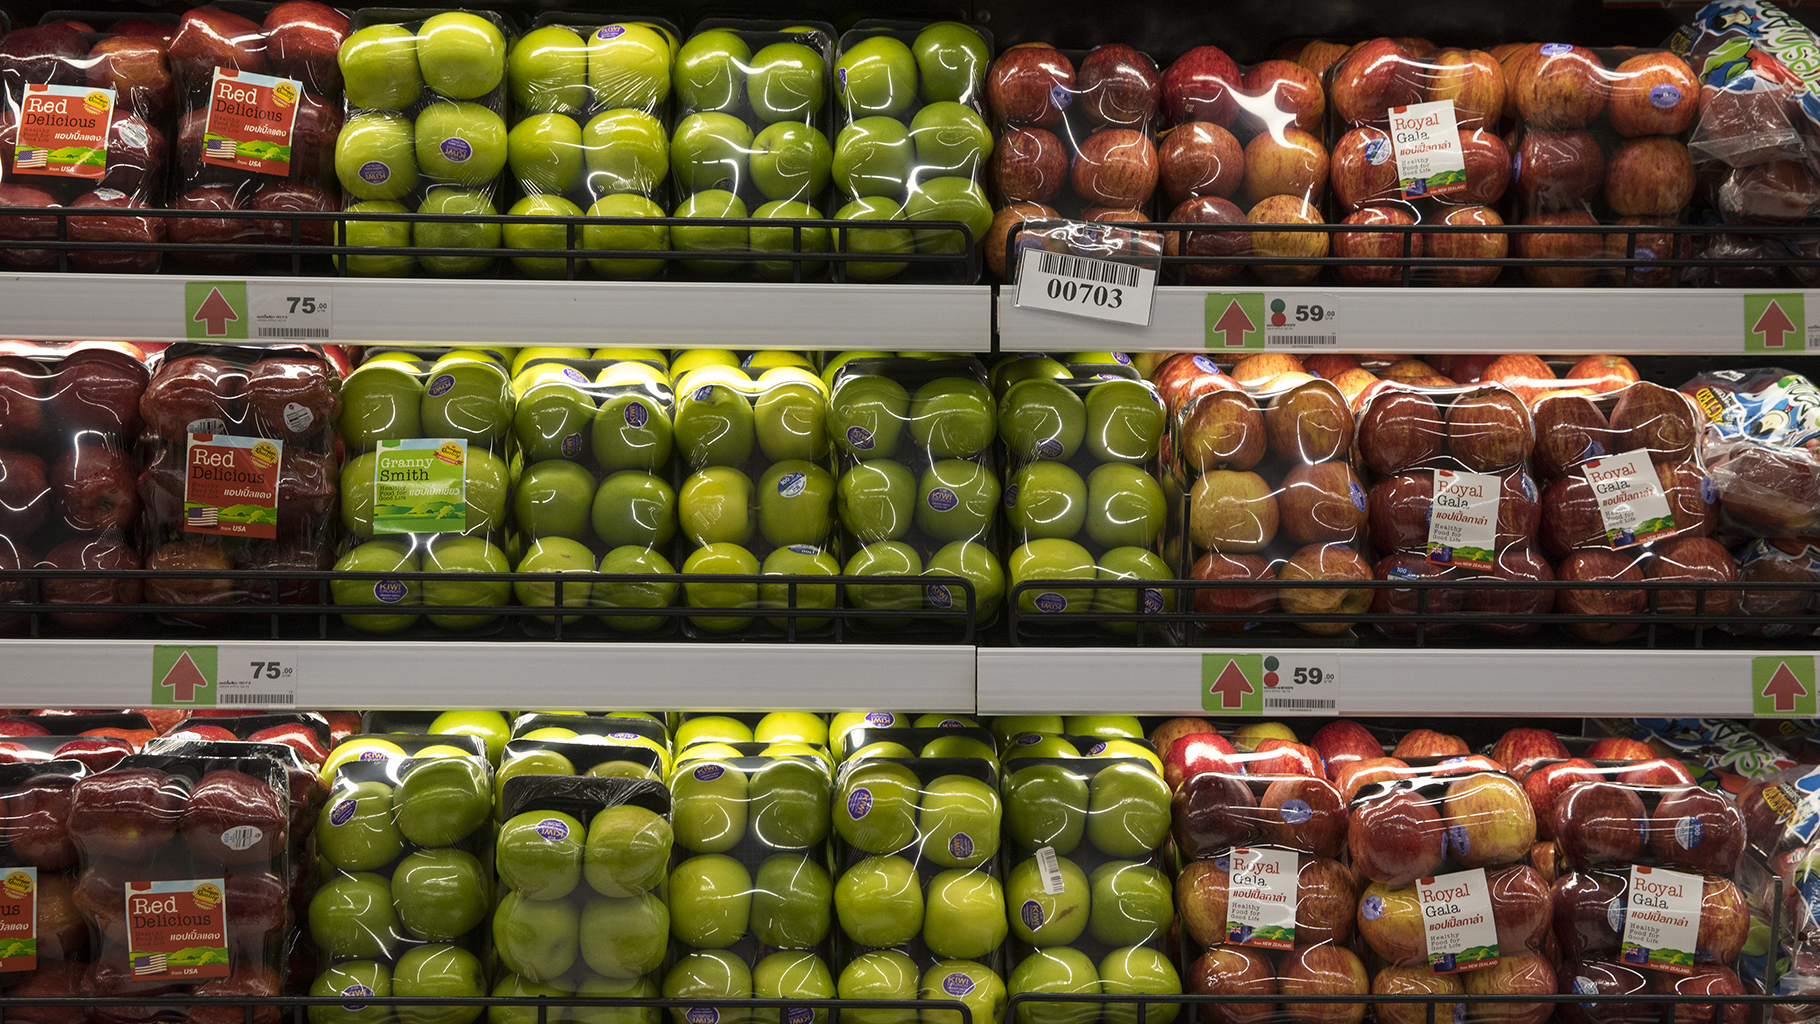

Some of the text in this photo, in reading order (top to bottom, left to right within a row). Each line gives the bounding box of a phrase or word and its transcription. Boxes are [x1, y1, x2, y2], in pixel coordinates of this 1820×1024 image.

[217, 83, 257, 105] Red
[27, 98, 67, 114] Red
[215, 99, 282, 122] Delicious
[25, 114, 96, 128] Delicious
[1394, 113, 1440, 131] Royal
[1397, 131, 1430, 143] Gala
[446, 148, 466, 158] KIWI
[1047, 278, 1123, 308] 00703
[193, 449, 234, 468] Red
[381, 458, 433, 469] Granny
[192, 466, 264, 484] Delicious
[381, 469, 429, 482] Smith
[1589, 463, 1637, 483] Royal
[780, 477, 791, 486] 100
[1438, 480, 1482, 497] Royal
[1597, 481, 1630, 494] Gala
[931, 492, 952, 500] KIWI
[1438, 495, 1469, 509] Gala
[930, 584, 950, 600] KIWI
[696, 764, 718, 773] KIWI
[333, 802, 350, 818] KIWI
[858, 793, 869, 815] KIWI
[542, 829, 564, 838] KIWI
[1233, 858, 1280, 875] Royal
[1233, 873, 1267, 886] Gala
[1421, 884, 1470, 903] Royal
[1634, 877, 1683, 898] Royal
[133, 896, 178, 914] Red
[1232, 903, 1260, 911] Healthy
[1633, 893, 1668, 909] Gala
[1032, 905, 1040, 926] KIWI
[1426, 904, 1460, 917] Gala
[134, 914, 211, 929] Delicious
[1630, 923, 1660, 933] Healthy
[170, 929, 220, 940] แอปเปิ้ลแดง
[948, 976, 968, 984] KIWI
